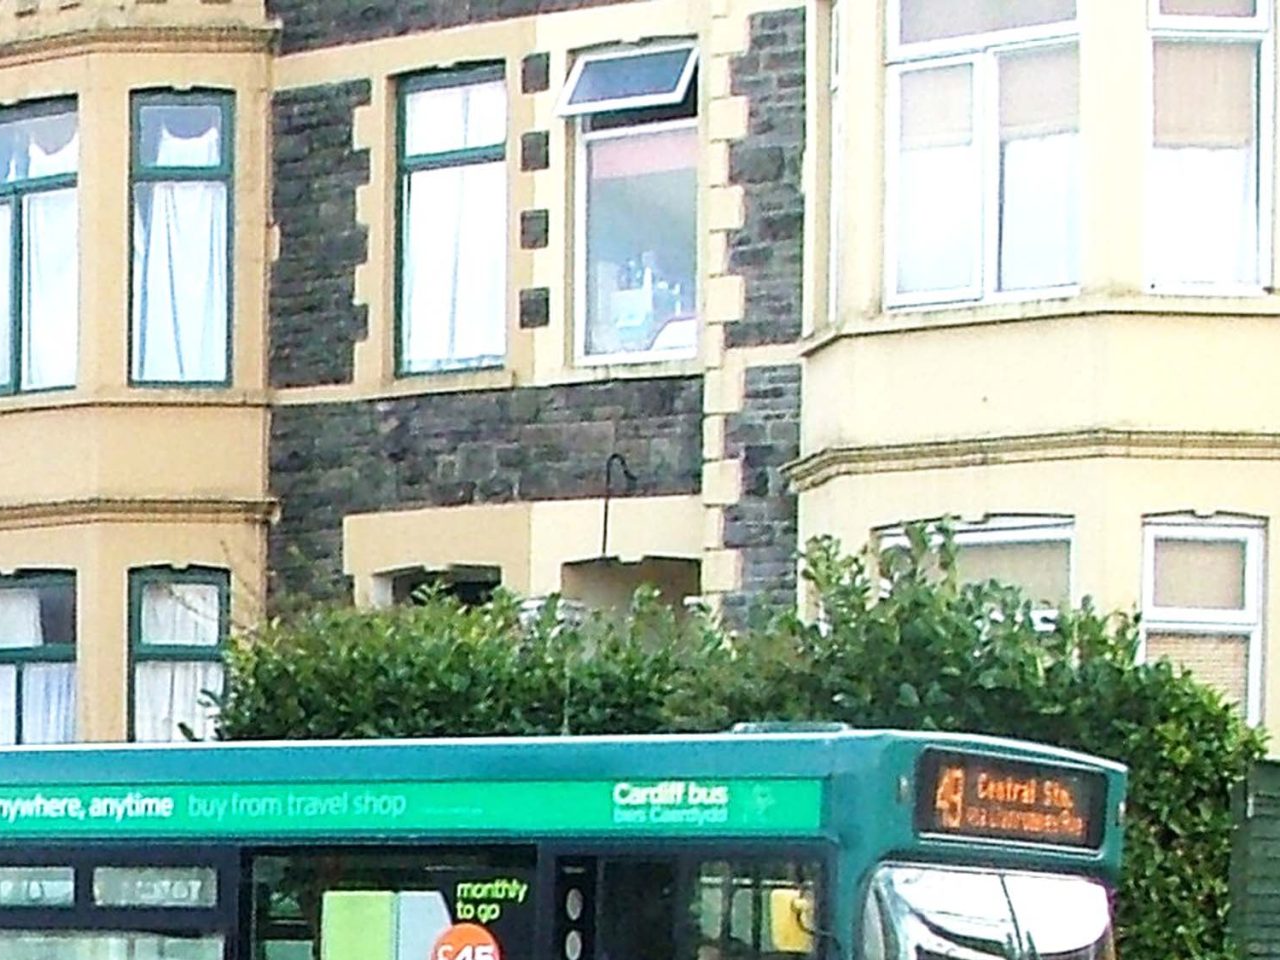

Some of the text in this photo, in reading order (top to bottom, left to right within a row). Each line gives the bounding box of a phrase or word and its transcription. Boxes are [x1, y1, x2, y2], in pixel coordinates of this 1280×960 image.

[612, 781, 729, 805] Cardiff bus
[977, 772, 1037, 804] Central
[88, 795, 174, 822] anytime
[187, 795, 229, 822] buy
[231, 794, 283, 818] from
[286, 791, 349, 818] travel
[354, 793, 407, 822] shop
[456, 879, 528, 902] monthly
[456, 903, 501, 923] to go
